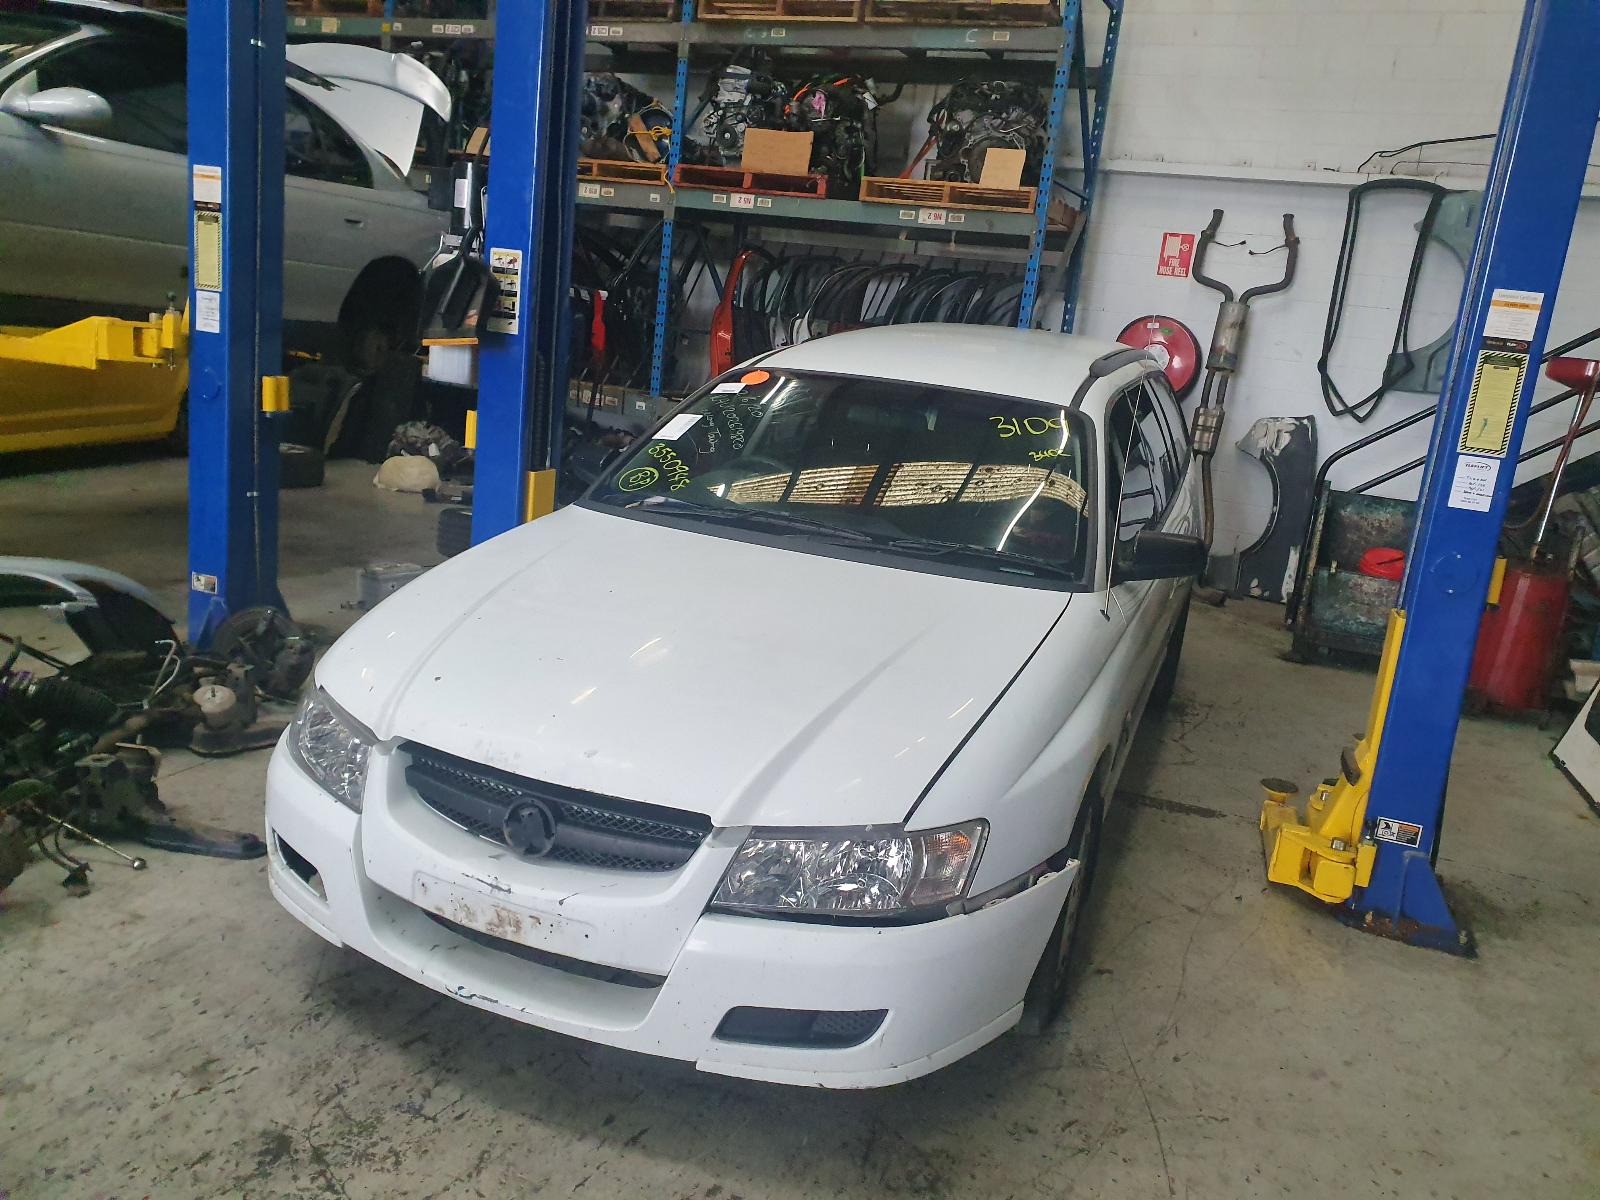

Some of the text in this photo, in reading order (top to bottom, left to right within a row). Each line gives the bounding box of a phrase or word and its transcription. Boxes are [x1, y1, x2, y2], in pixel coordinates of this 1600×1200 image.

[927, 212, 932, 220] 2
[1169, 258, 1180, 267] FIRE
[1160, 266, 1186, 276] HOSE REEL
